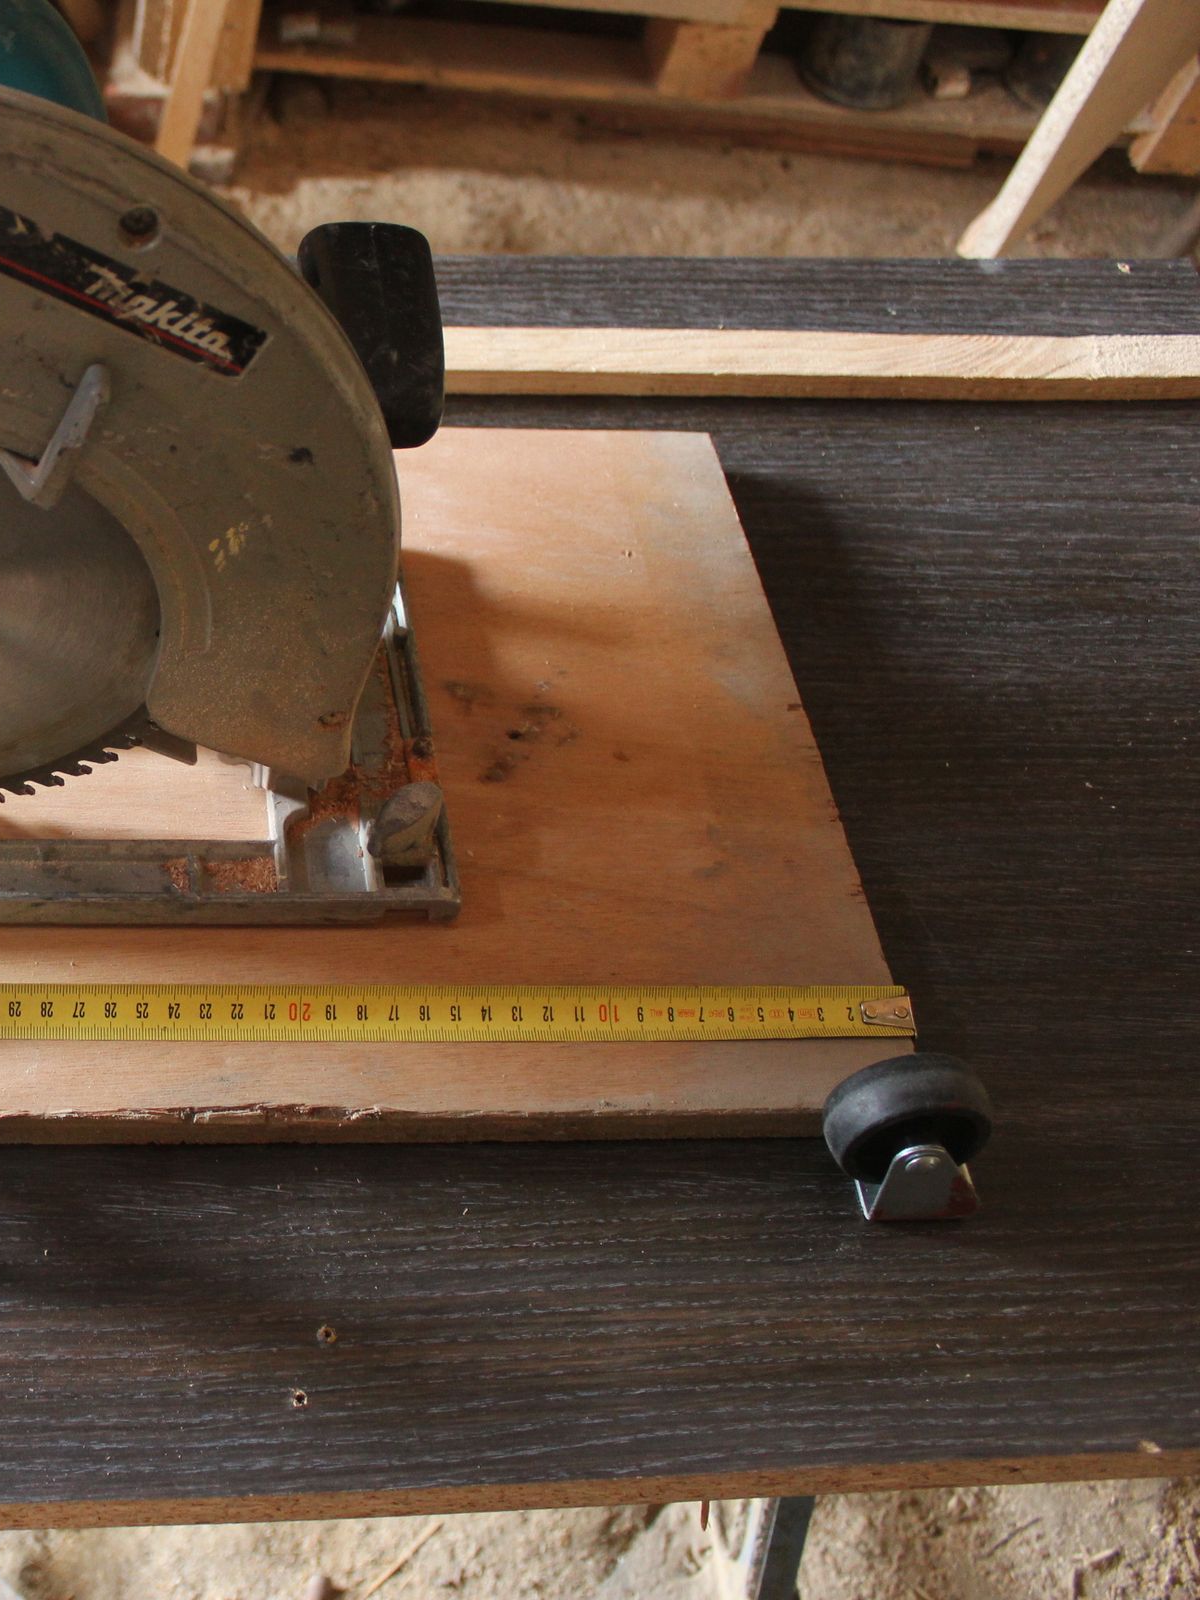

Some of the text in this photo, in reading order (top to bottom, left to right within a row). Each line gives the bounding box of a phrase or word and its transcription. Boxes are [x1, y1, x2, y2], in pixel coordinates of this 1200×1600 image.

[9, 1001, 21, 1017] 29
[41, 1002, 53, 1017] 28
[73, 1002, 85, 1018] 27
[105, 1002, 117, 1018] 26
[136, 1003, 148, 1019] 25
[168, 1003, 180, 1019] 24
[200, 1003, 212, 1020] 23
[231, 1003, 243, 1020] 22
[265, 1004, 275, 1020] 21
[289, 1003, 310, 1021] 20
[326, 1005, 336, 1020] 19
[357, 1005, 368, 1021] 18
[389, 1005, 399, 1021] 17
[420, 1006, 430, 1021] 16
[451, 1006, 461, 1021] 15
[481, 1006, 492, 1021] 14
[512, 1006, 523, 1021] 13
[543, 1006, 554, 1022] 12
[575, 1006, 584, 1022] 11
[599, 1005, 619, 1022] 10
[637, 1007, 643, 1022] 9
[668, 1007, 674, 1022] 8
[699, 1007, 705, 1022] 7
[728, 1007, 734, 1022] 6
[757, 1008, 764, 1022] 5
[788, 1008, 794, 1022] 4
[817, 1008, 824, 1022] 3
[846, 1007, 854, 1021] 2
